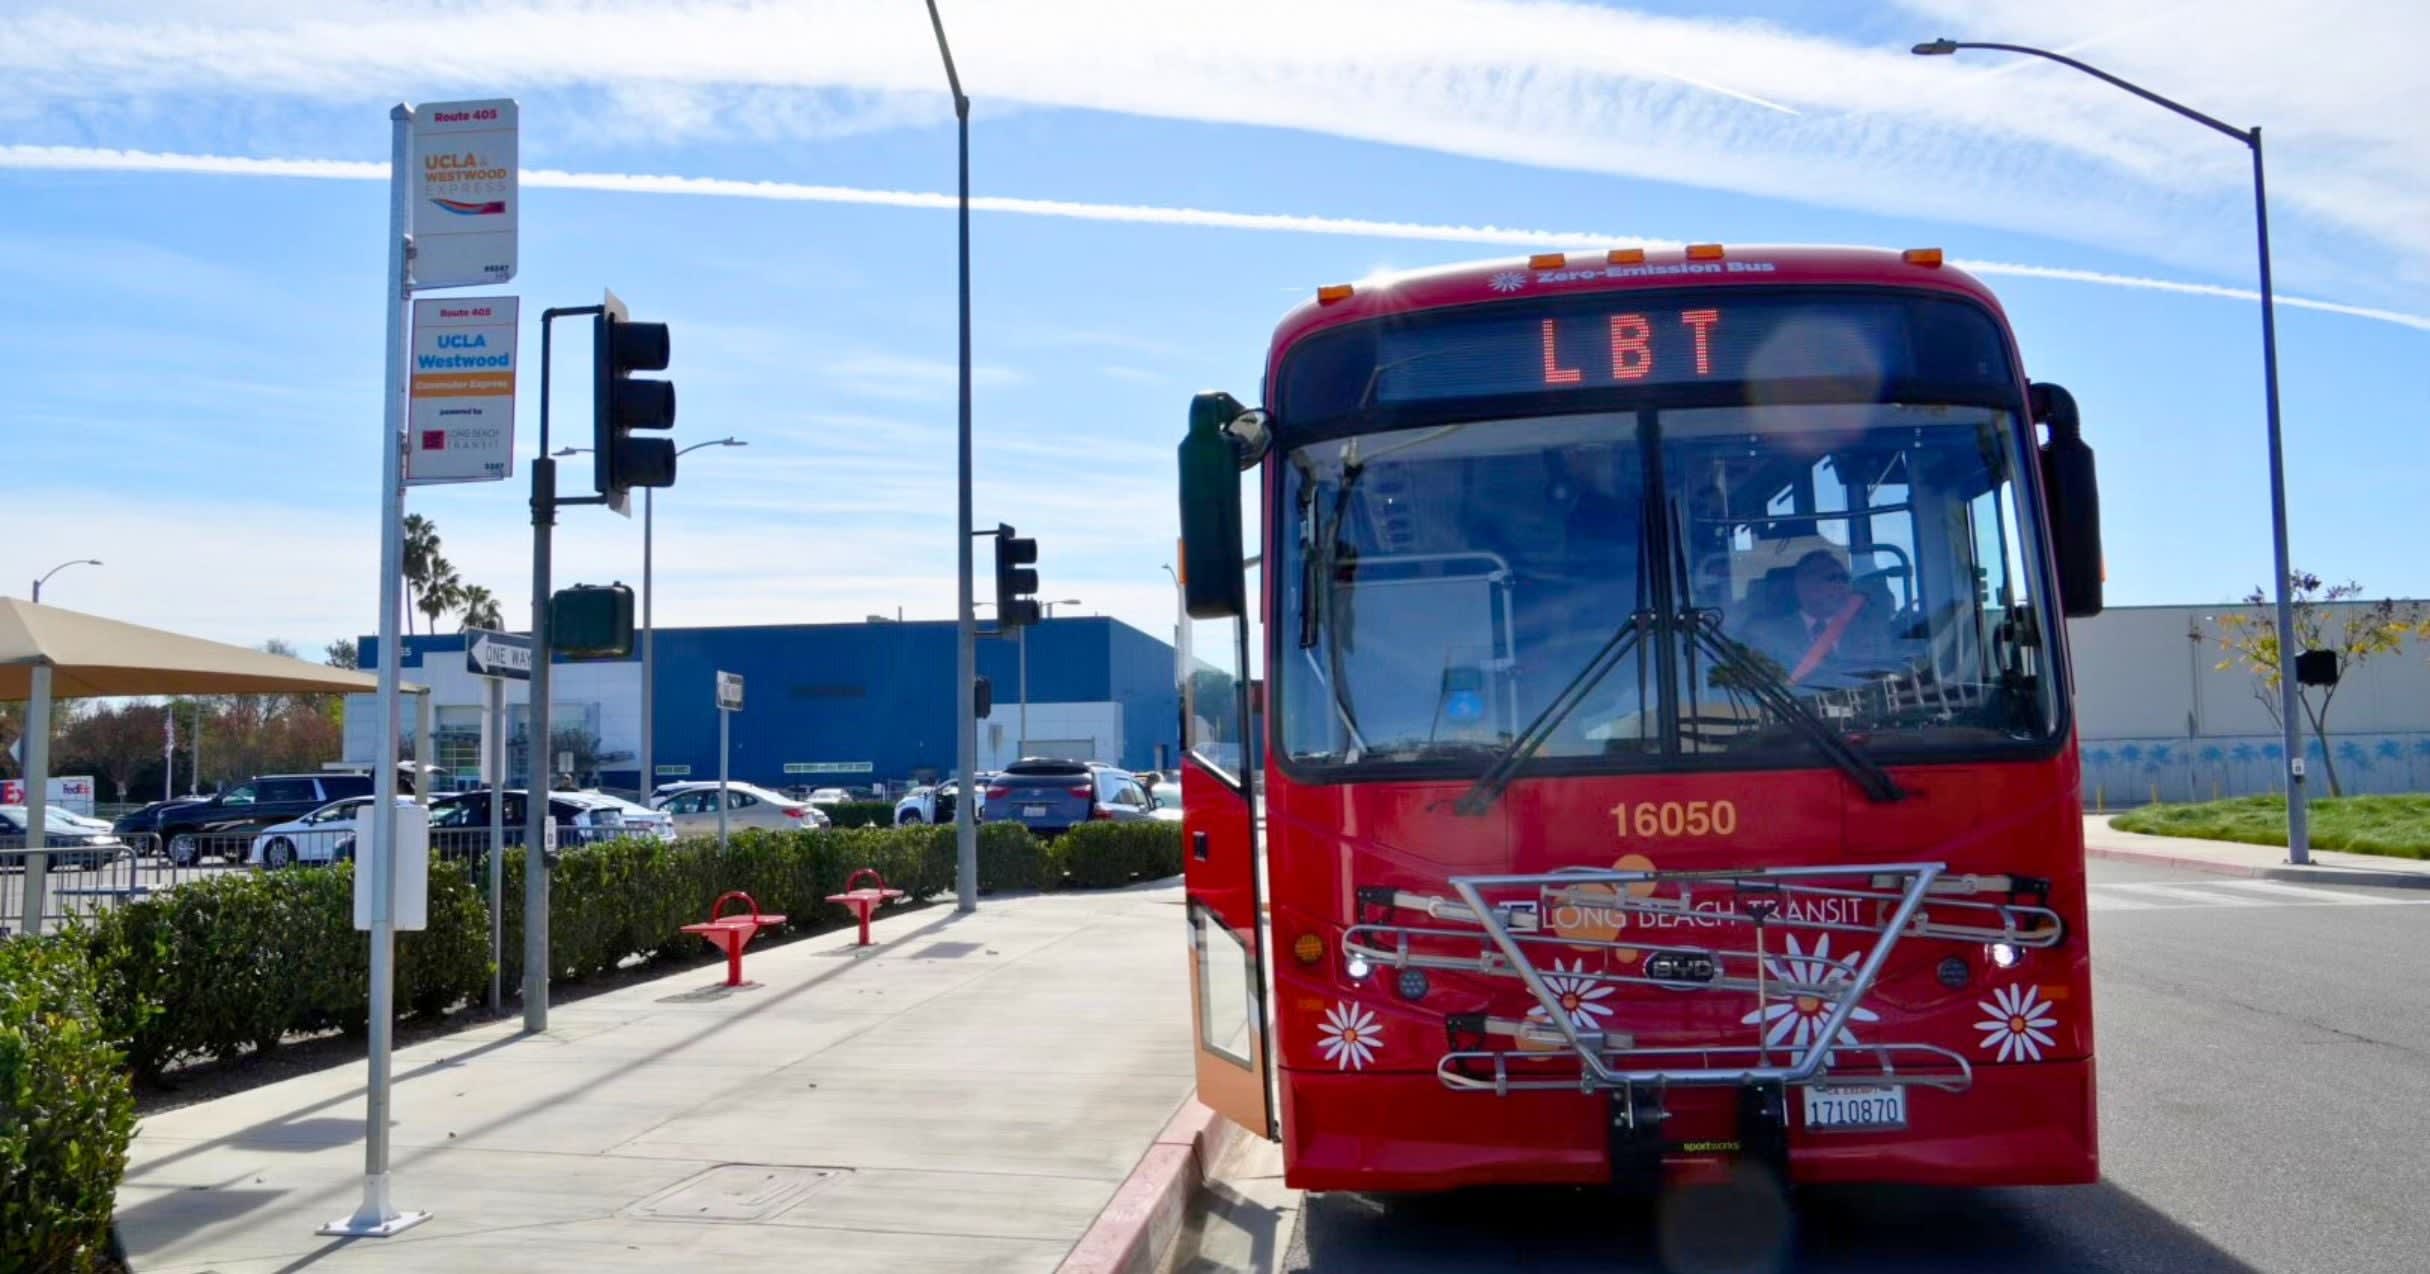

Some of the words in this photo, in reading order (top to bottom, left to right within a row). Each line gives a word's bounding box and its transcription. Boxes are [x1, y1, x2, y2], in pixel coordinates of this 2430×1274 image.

[434, 111, 470, 123] Route
[472, 109, 498, 120] 405
[425, 153, 477, 169] UCLA
[425, 168, 507, 183] WESTWOOD
[425, 181, 507, 195] EXPRESS
[1537, 262, 1720, 283] Zero-Emission
[1727, 262, 1775, 272] Bus
[440, 309, 469, 318] Route
[437, 335, 486, 349] UCLA
[418, 352, 509, 369] Westwood
[415, 380, 468, 390] Commuter
[470, 379, 508, 390] Express
[440, 408, 471, 416] powered
[486, 645, 507, 665] ONE
[1610, 800, 1736, 837] 16050
[1542, 905, 1627, 929] LONG
[1653, 960, 1712, 977] BYD
[1812, 1098, 1897, 1124] 1710870
